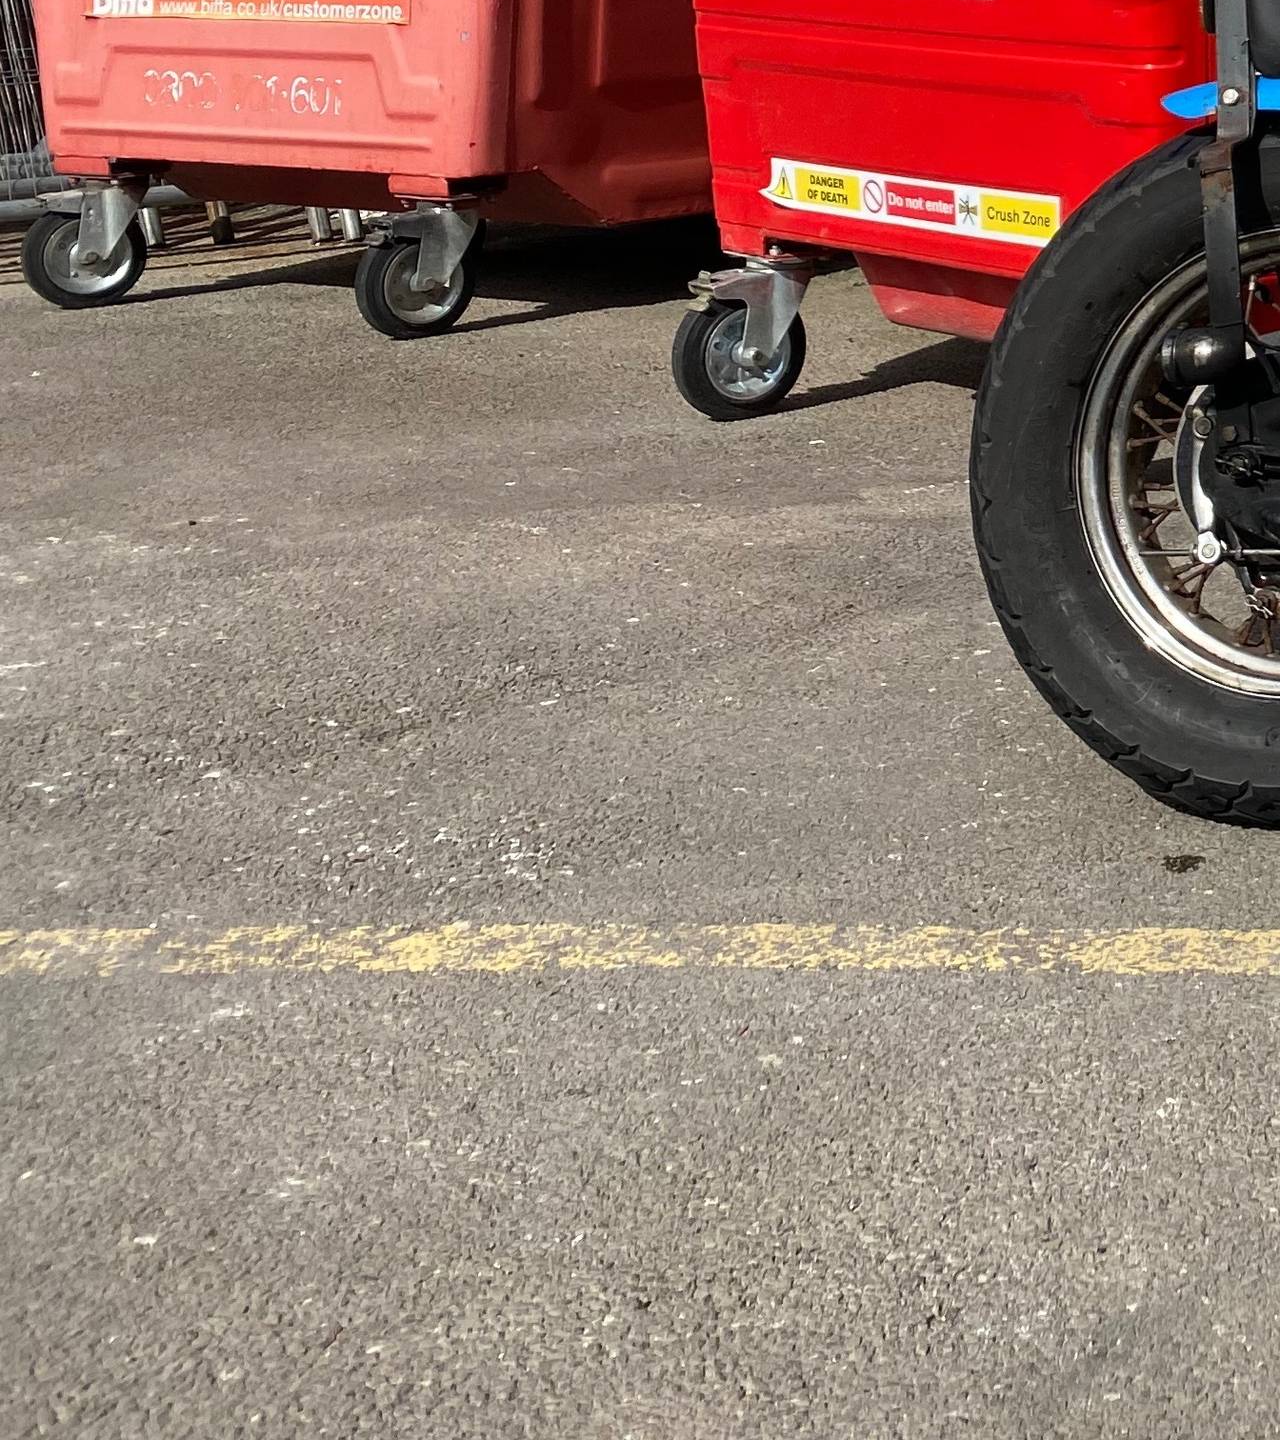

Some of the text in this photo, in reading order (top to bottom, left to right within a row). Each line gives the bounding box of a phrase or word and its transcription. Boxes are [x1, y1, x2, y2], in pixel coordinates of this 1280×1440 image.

[809, 174, 845, 190] DANGER
[807, 190, 849, 206] OF DEATH
[887, 191, 955, 214] Do not enter
[986, 205, 1051, 228] Crush Zone
